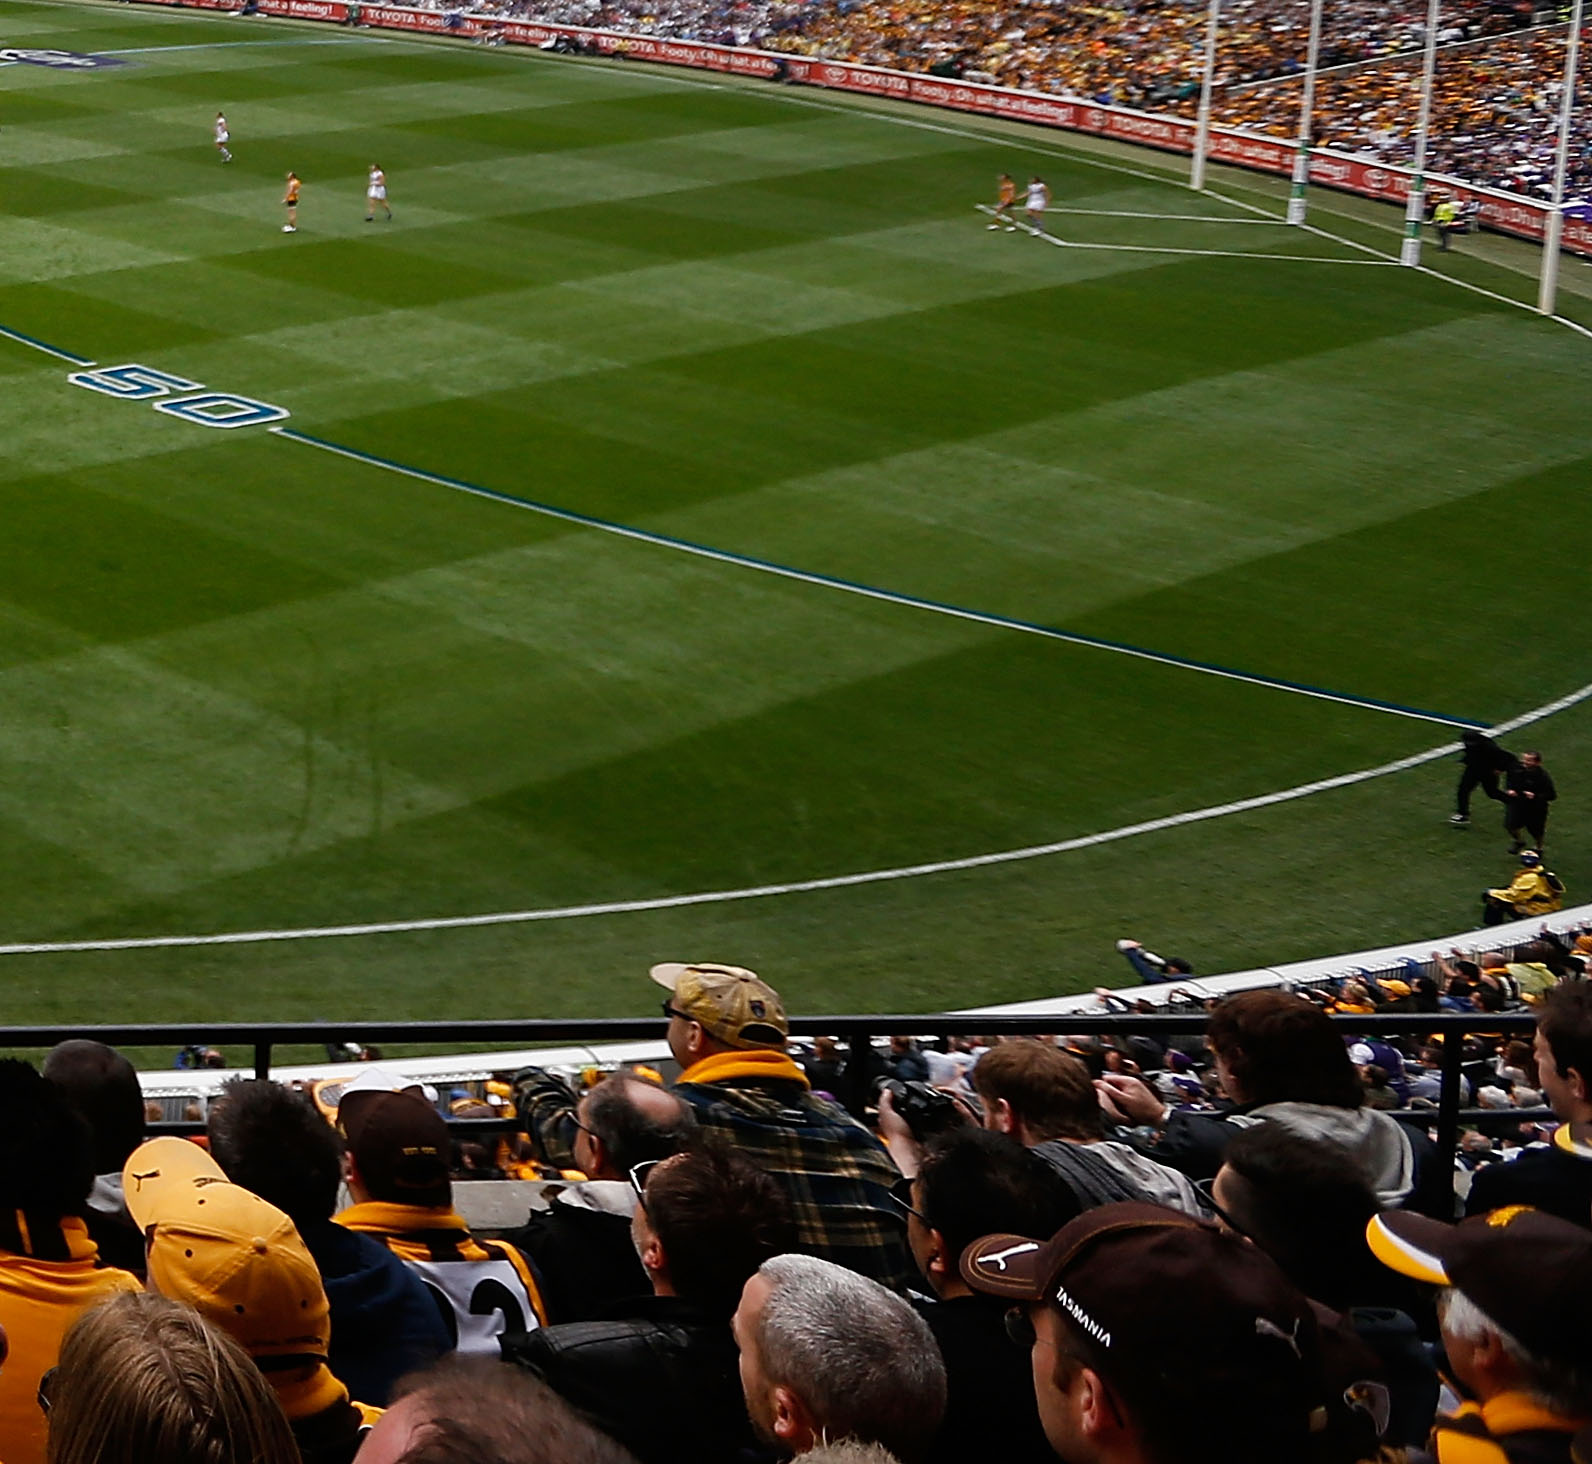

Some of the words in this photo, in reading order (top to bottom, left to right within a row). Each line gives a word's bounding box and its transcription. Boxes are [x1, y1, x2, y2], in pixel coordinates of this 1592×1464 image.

[291, 3, 333, 18] feeling!
[367, 8, 416, 24] TOYOTA
[849, 71, 908, 92] TOYOTA
[68, 363, 292, 429] 50
[1056, 1285, 1111, 1348] TASMANIA
